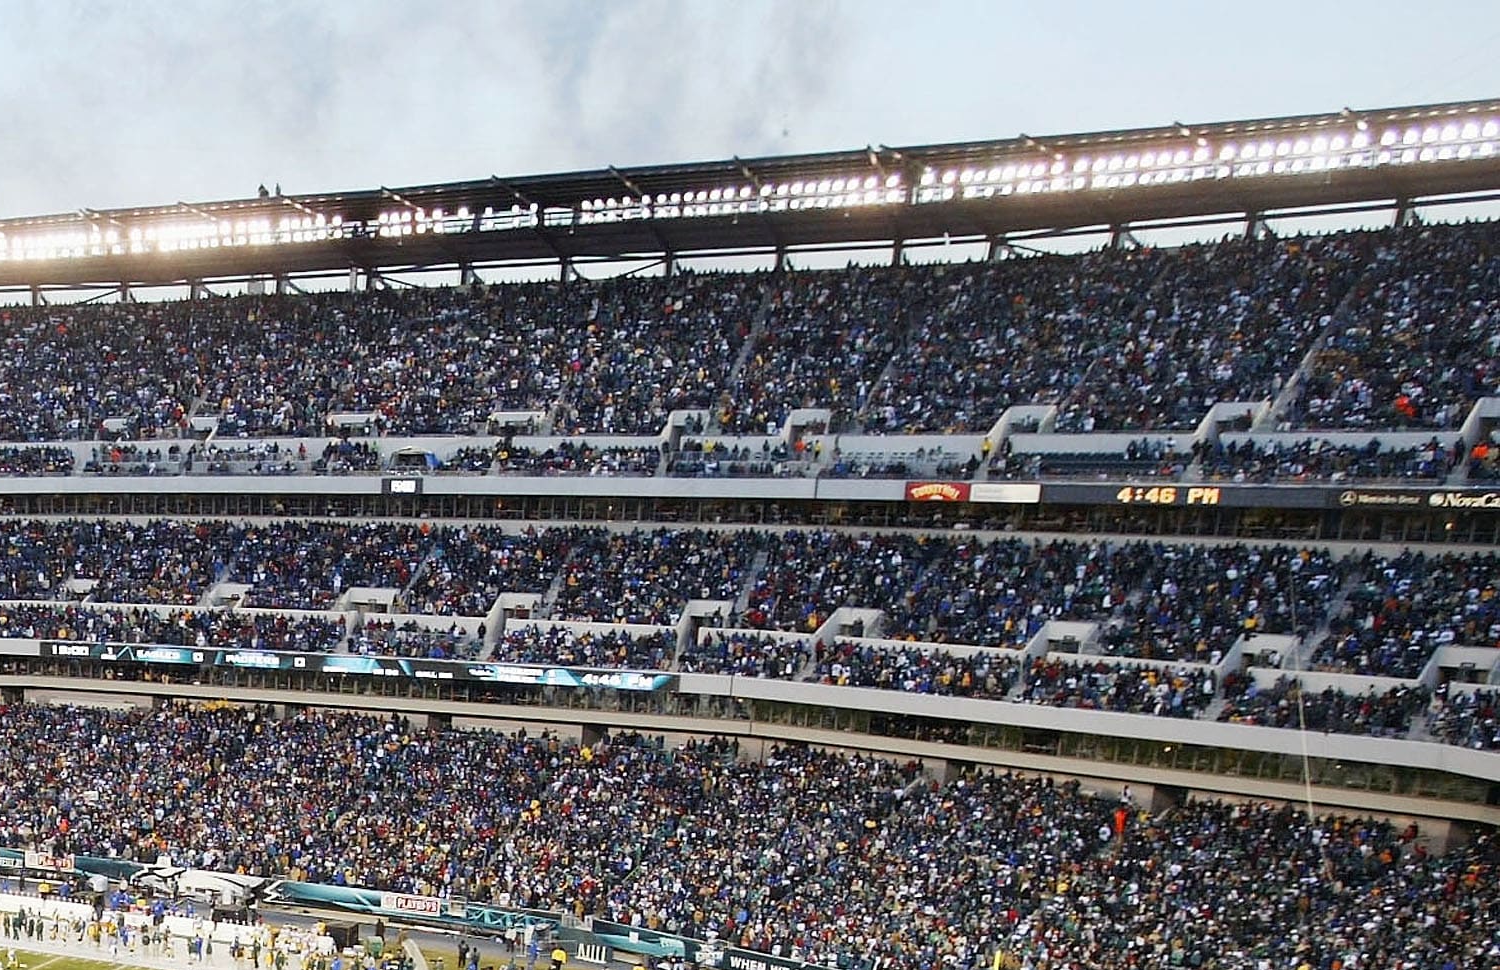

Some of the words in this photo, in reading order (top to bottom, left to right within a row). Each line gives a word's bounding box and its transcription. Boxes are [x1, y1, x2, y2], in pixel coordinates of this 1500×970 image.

[1117, 487, 1176, 503] 4:46
[1187, 488, 1220, 505] PM
[396, 897, 439, 912] PLAYOFFS
